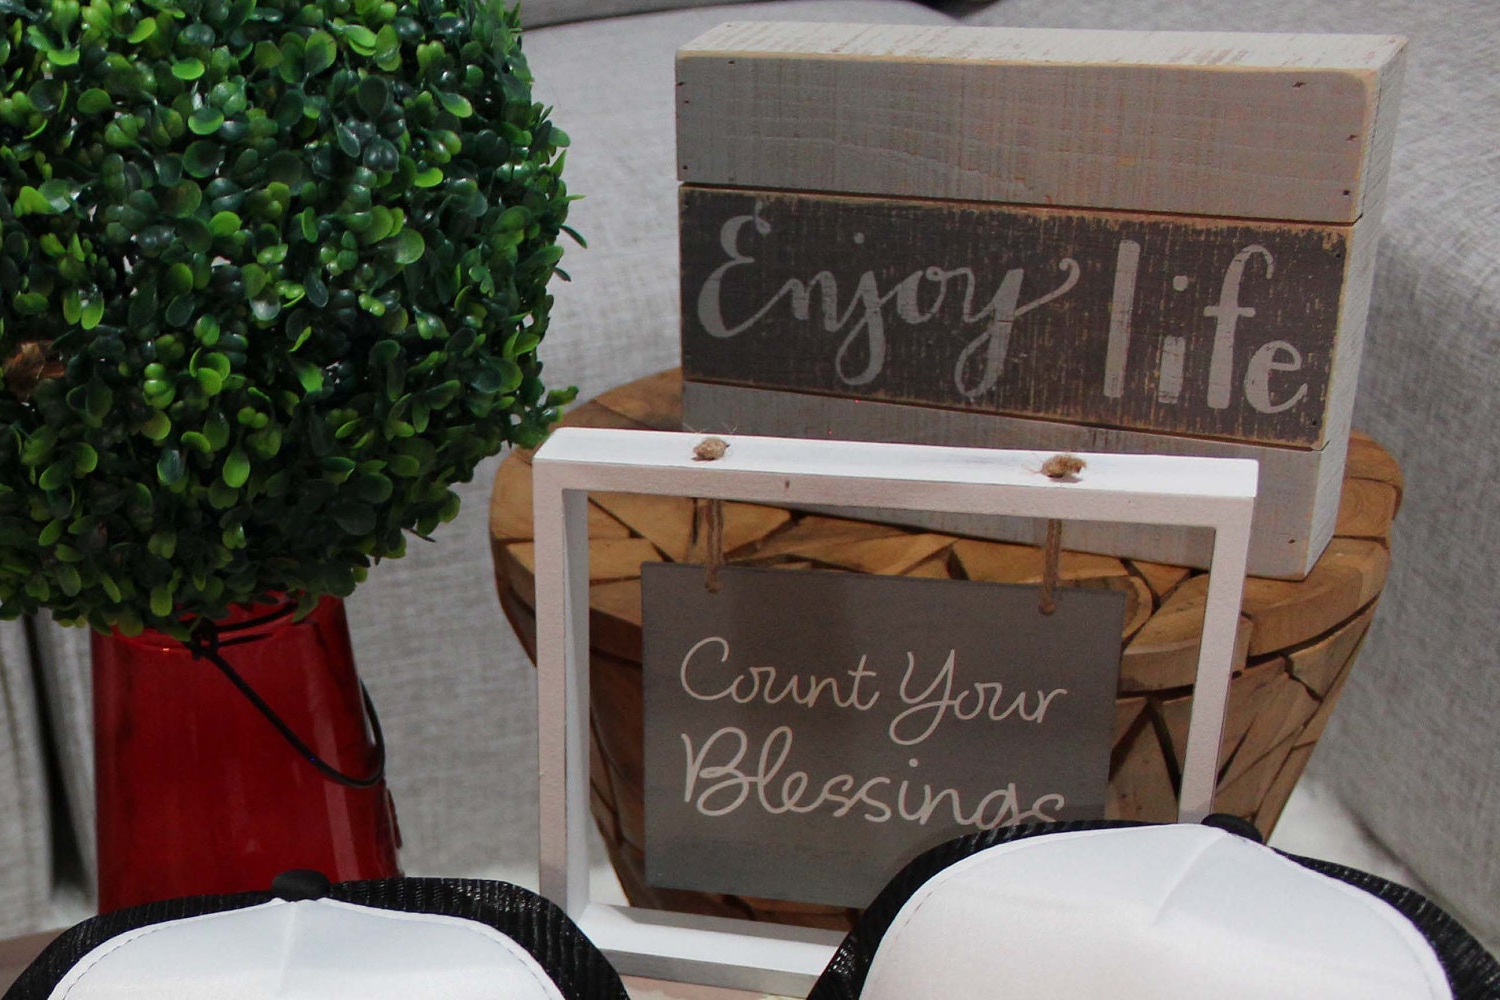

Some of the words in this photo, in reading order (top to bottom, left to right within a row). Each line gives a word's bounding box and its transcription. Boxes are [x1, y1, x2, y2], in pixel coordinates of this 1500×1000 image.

[699, 202, 1081, 399] Enjoy
[1103, 238, 1308, 414] life
[680, 637, 880, 710] Count
[888, 648, 1068, 746] Your
